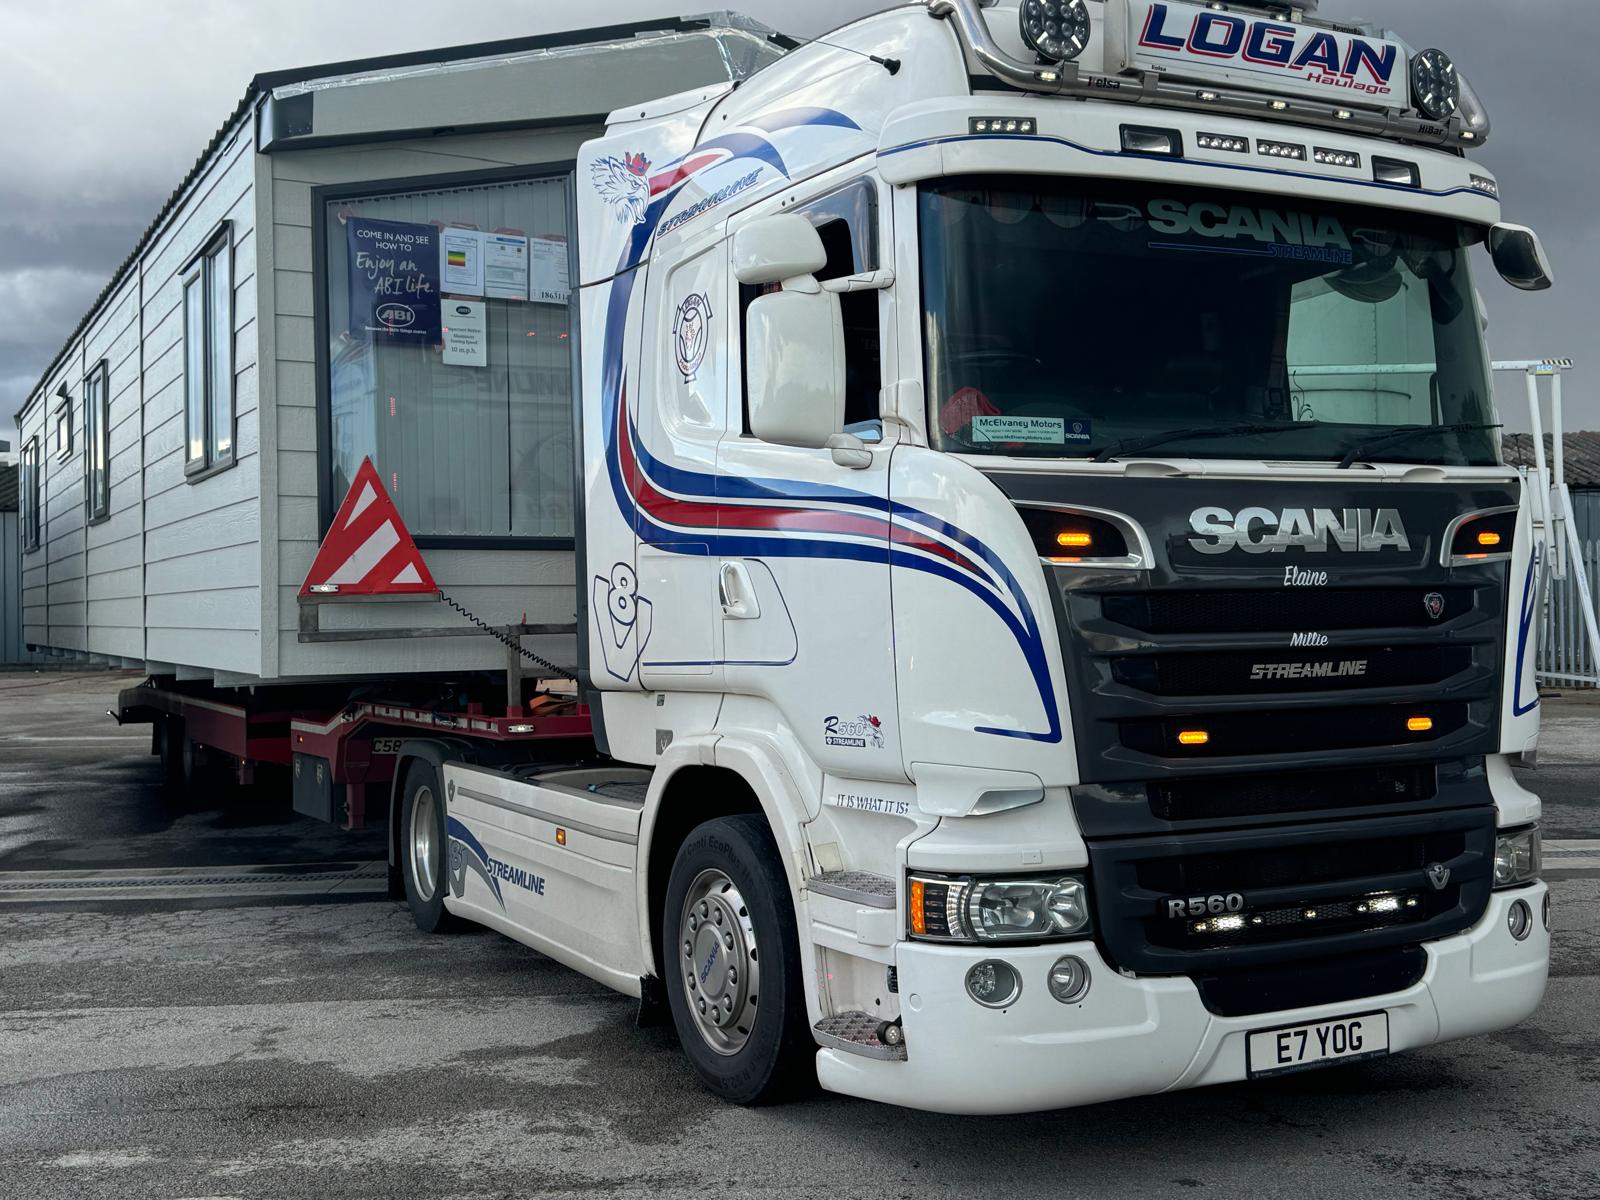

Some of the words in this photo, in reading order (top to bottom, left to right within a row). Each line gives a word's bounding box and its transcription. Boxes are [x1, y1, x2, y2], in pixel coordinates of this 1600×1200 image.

[1138, 4, 1397, 86] LOGAN
[1307, 73, 1392, 94] Haulage
[1418, 124, 1444, 136] HiBar
[1147, 199, 1352, 250] SCANIA
[356, 230, 382, 239] COME
[384, 232, 394, 240] IN
[394, 234, 414, 243] AND
[415, 235, 430, 245] SEE
[375, 241, 397, 250] HOW
[399, 243, 412, 252] TO
[1266, 243, 1352, 265] STREAMLINE
[356, 252, 395, 280] Enjoy
[399, 260, 418, 271] an
[374, 277, 404, 295] ABI
[381, 309, 412, 321] ABI
[979, 418, 1029, 429] McElvaney
[1030, 419, 1062, 429] Motors
[1064, 432, 1091, 440] SCANIA
[1188, 506, 1412, 554] SCANIA
[1283, 565, 1328, 586] Elaine
[1290, 632, 1329, 647] Millie
[1250, 660, 1368, 680] STREAMLINE
[832, 737, 865, 747] STREAMLINE
[836, 793, 846, 807] IT
[846, 795, 855, 808] IS
[856, 796, 884, 811] WHAT
[884, 800, 895, 815] IT
[487, 858, 546, 896] STREAMLINE
[1168, 892, 1244, 919] R560
[700, 941, 720, 984] SCANIA
[1276, 1029, 1309, 1064] E7
[1315, 1021, 1363, 1057] YOG
